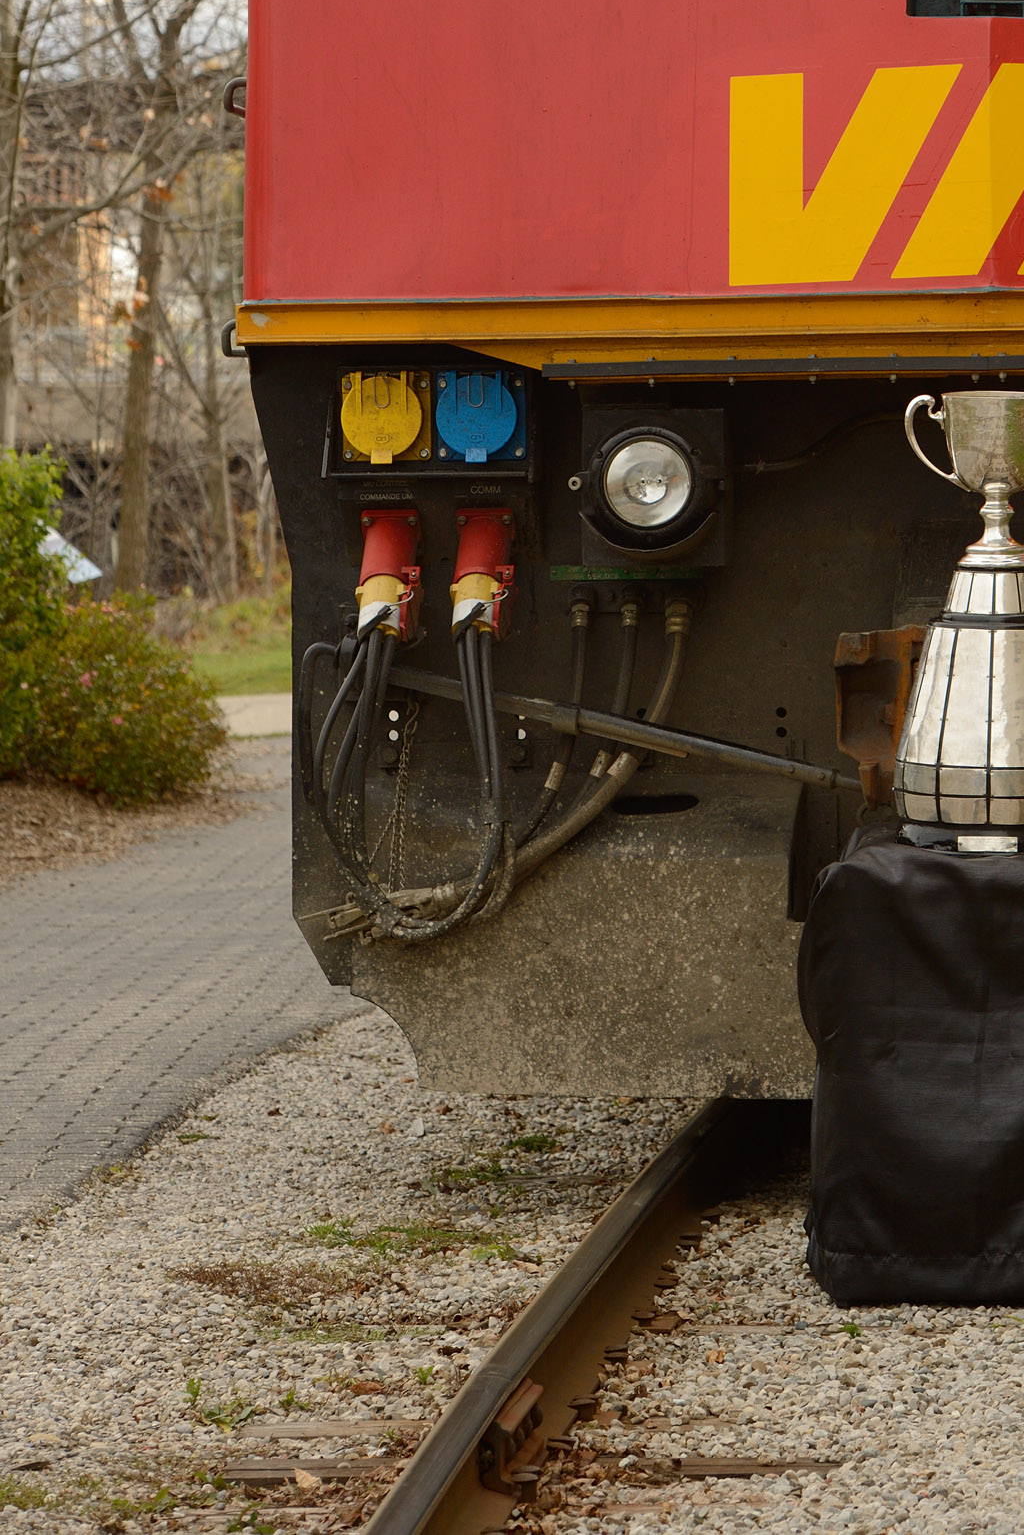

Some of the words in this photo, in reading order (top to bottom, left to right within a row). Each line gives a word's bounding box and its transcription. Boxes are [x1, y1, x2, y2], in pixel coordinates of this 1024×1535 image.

[470, 485, 502, 495] COMM
[359, 493, 401, 501] COMMANDE
[401, 492, 413, 500] UM
